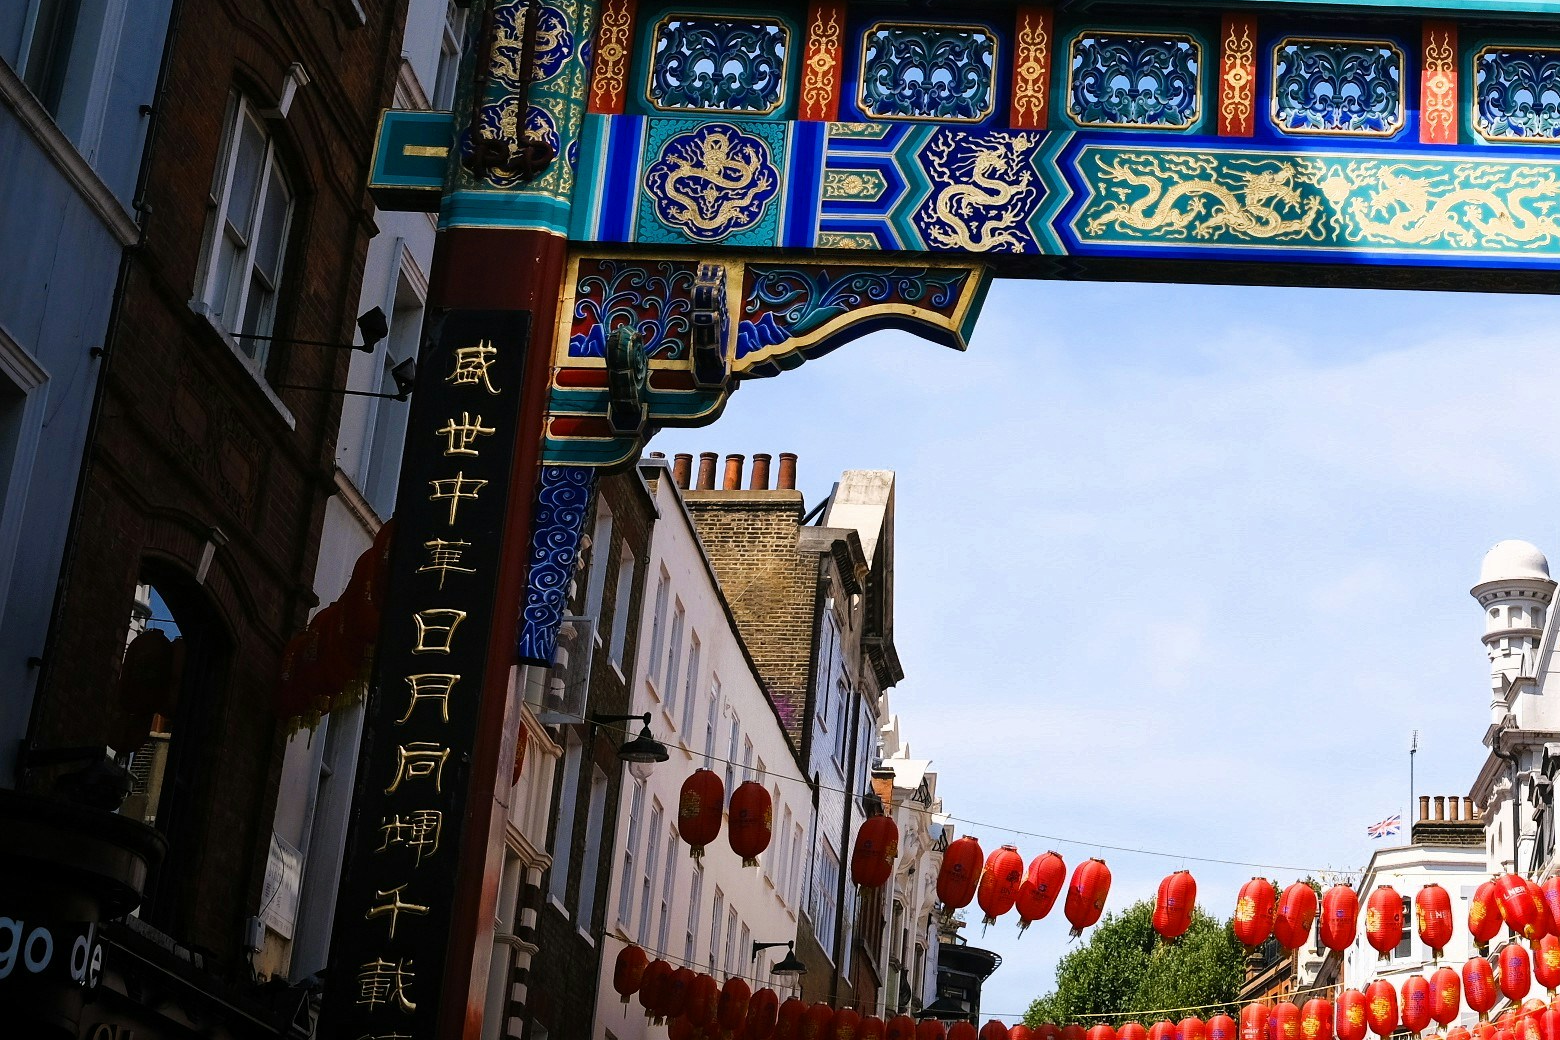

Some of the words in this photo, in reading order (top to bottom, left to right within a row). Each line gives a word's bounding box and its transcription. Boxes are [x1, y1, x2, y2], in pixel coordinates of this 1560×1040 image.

[355, 338, 502, 1040] 盛世中華日月同輝千載
